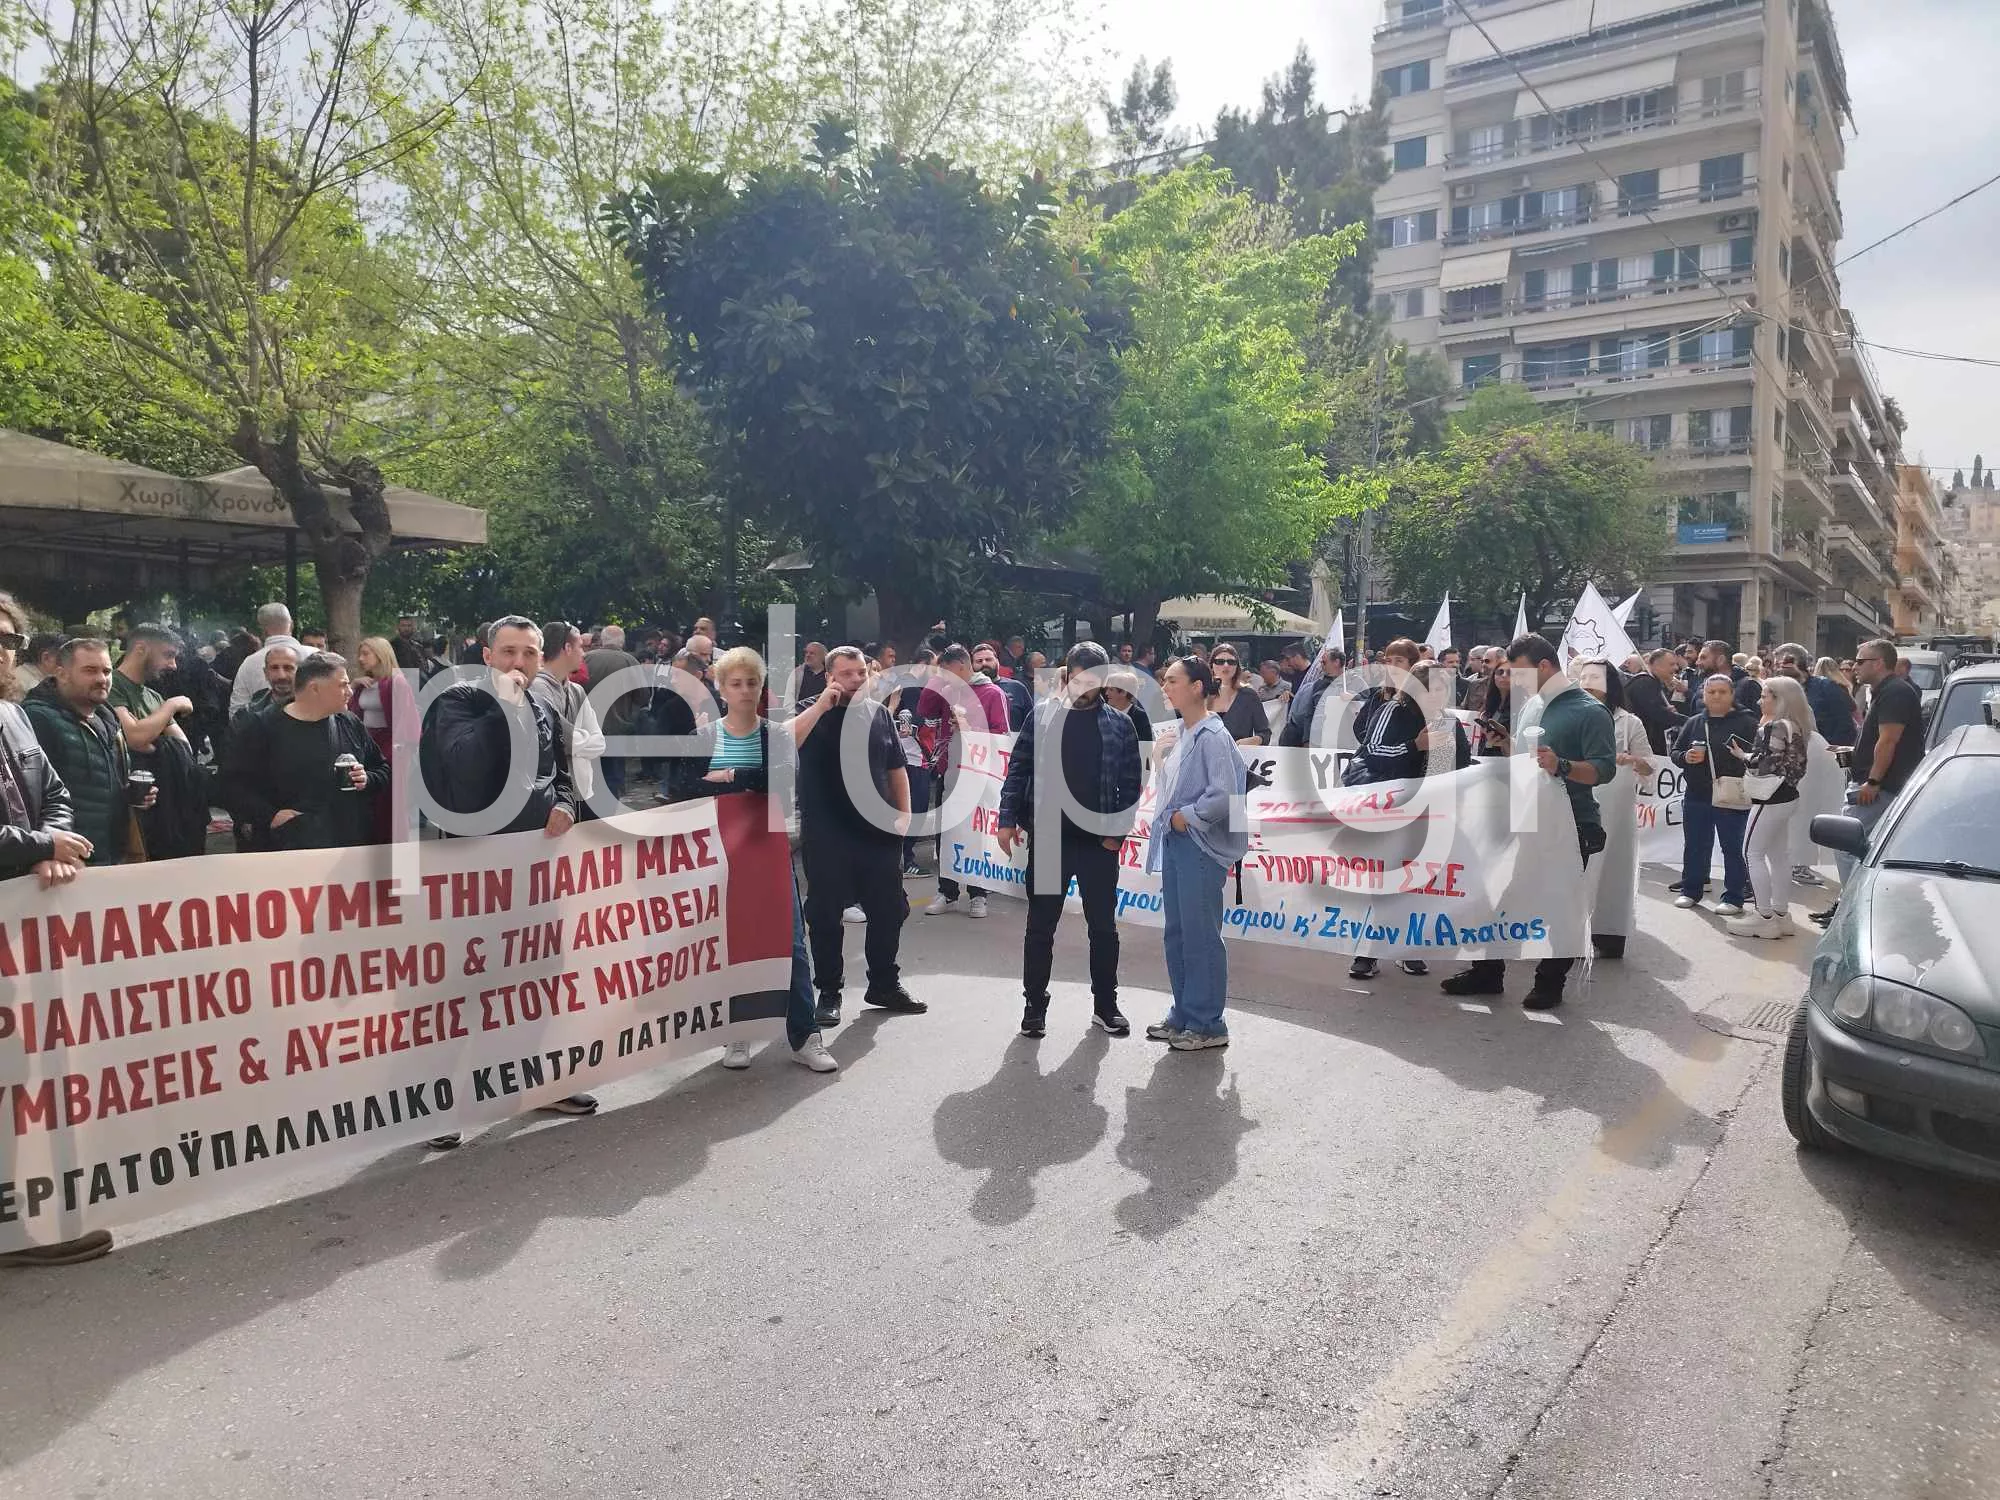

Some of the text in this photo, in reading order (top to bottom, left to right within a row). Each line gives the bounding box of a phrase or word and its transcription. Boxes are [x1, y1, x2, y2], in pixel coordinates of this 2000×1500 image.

[422, 868, 513, 921] ΤΗΝ
[528, 844, 623, 906] ΠΑΛΗ
[636, 828, 719, 880] ΜΑΣ
[1223, 901, 1286, 936] ισμού
[270, 942, 446, 1009] ΠΟΛΕΜΟ
[463, 936, 487, 976] &
[501, 919, 564, 968] ΤΗΝ
[572, 884, 720, 951] ΑΚΡΙΒΕΙΑ
[0, 935, 721, 1136] ΜΒΑΣΕΙΣ & ΑΥΞΗΣΕΙΣ ΣΤΟΥΣ ΜΙΣΘΟΥΣ
[473, 1039, 604, 1102] ΚΕΝΤΡΟ
[618, 1000, 724, 1058] ΠΑΤΡΑΣ
